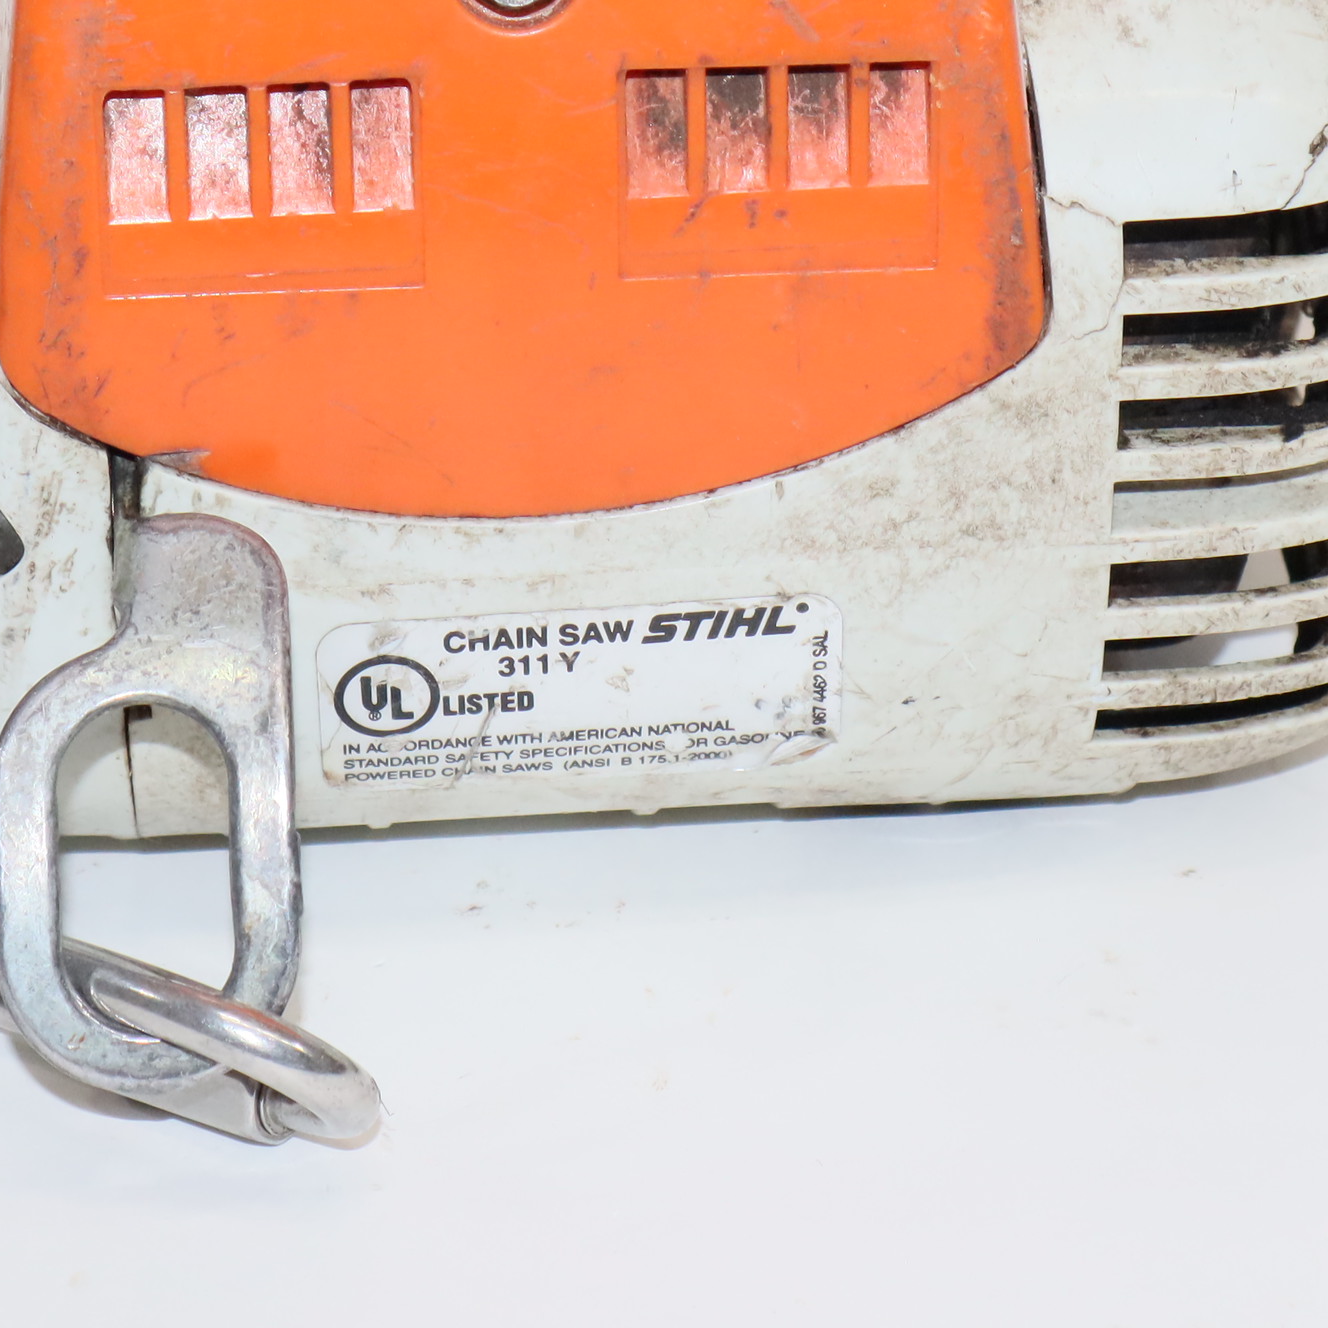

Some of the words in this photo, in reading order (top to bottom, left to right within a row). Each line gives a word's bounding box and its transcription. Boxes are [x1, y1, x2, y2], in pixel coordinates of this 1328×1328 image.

[443, 626, 548, 653] CHAIN
[558, 619, 634, 646] SAW
[641, 605, 796, 644] STIHL
[812, 630, 829, 657] SAL
[498, 653, 549, 677] 311
[559, 651, 580, 673] Y
[442, 691, 535, 716] LISTED
[343, 744, 361, 755] IN
[497, 733, 542, 745] WITH
[548, 726, 642, 743] AMERICAN
[648, 719, 735, 736] NATIONAL
[343, 755, 439, 769] STANDARD
[519, 741, 665, 759] SPECIFICATIONS
[344, 769, 436, 782] POWERED
[502, 762, 553, 773] SAWS
[563, 758, 610, 771] (ANSI
[621, 756, 632, 766] B
